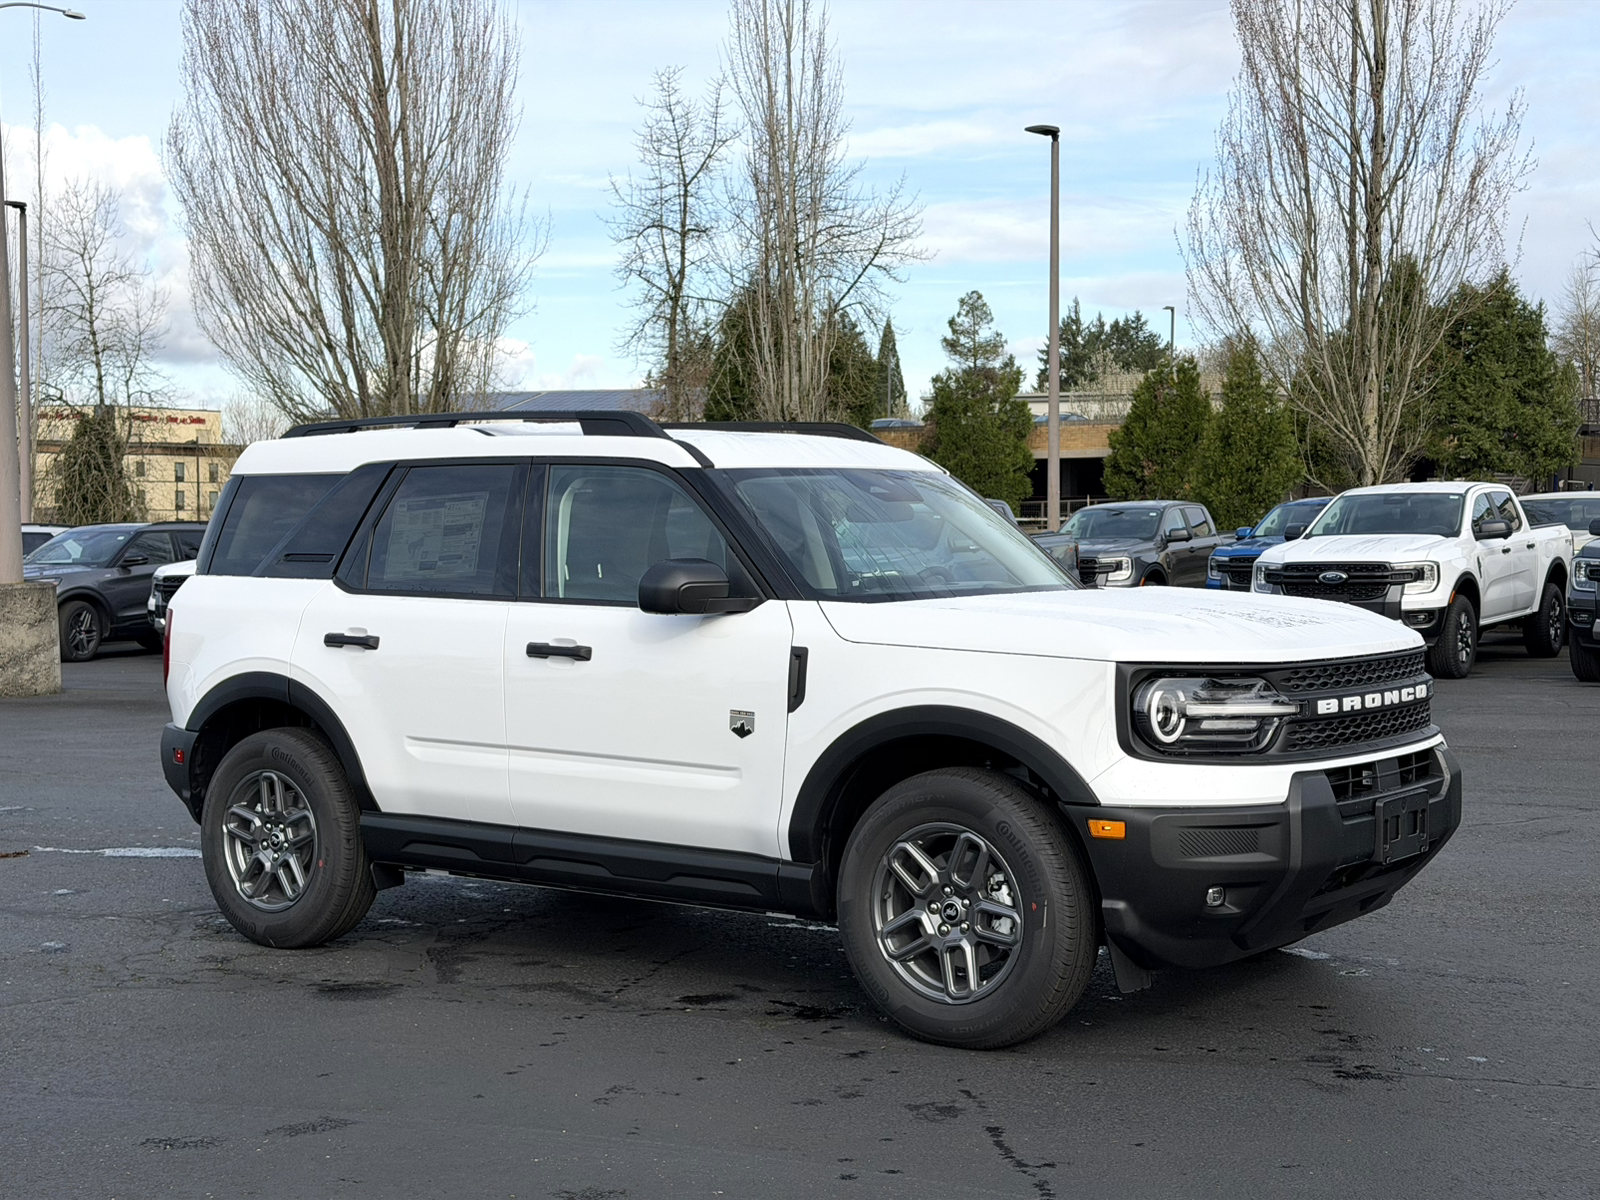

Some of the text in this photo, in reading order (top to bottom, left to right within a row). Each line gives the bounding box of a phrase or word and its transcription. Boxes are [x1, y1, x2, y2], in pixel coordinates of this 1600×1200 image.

[1317, 684, 1427, 714] BRONCO
[271, 747, 315, 787] Continental
[995, 819, 1046, 899] Continental
